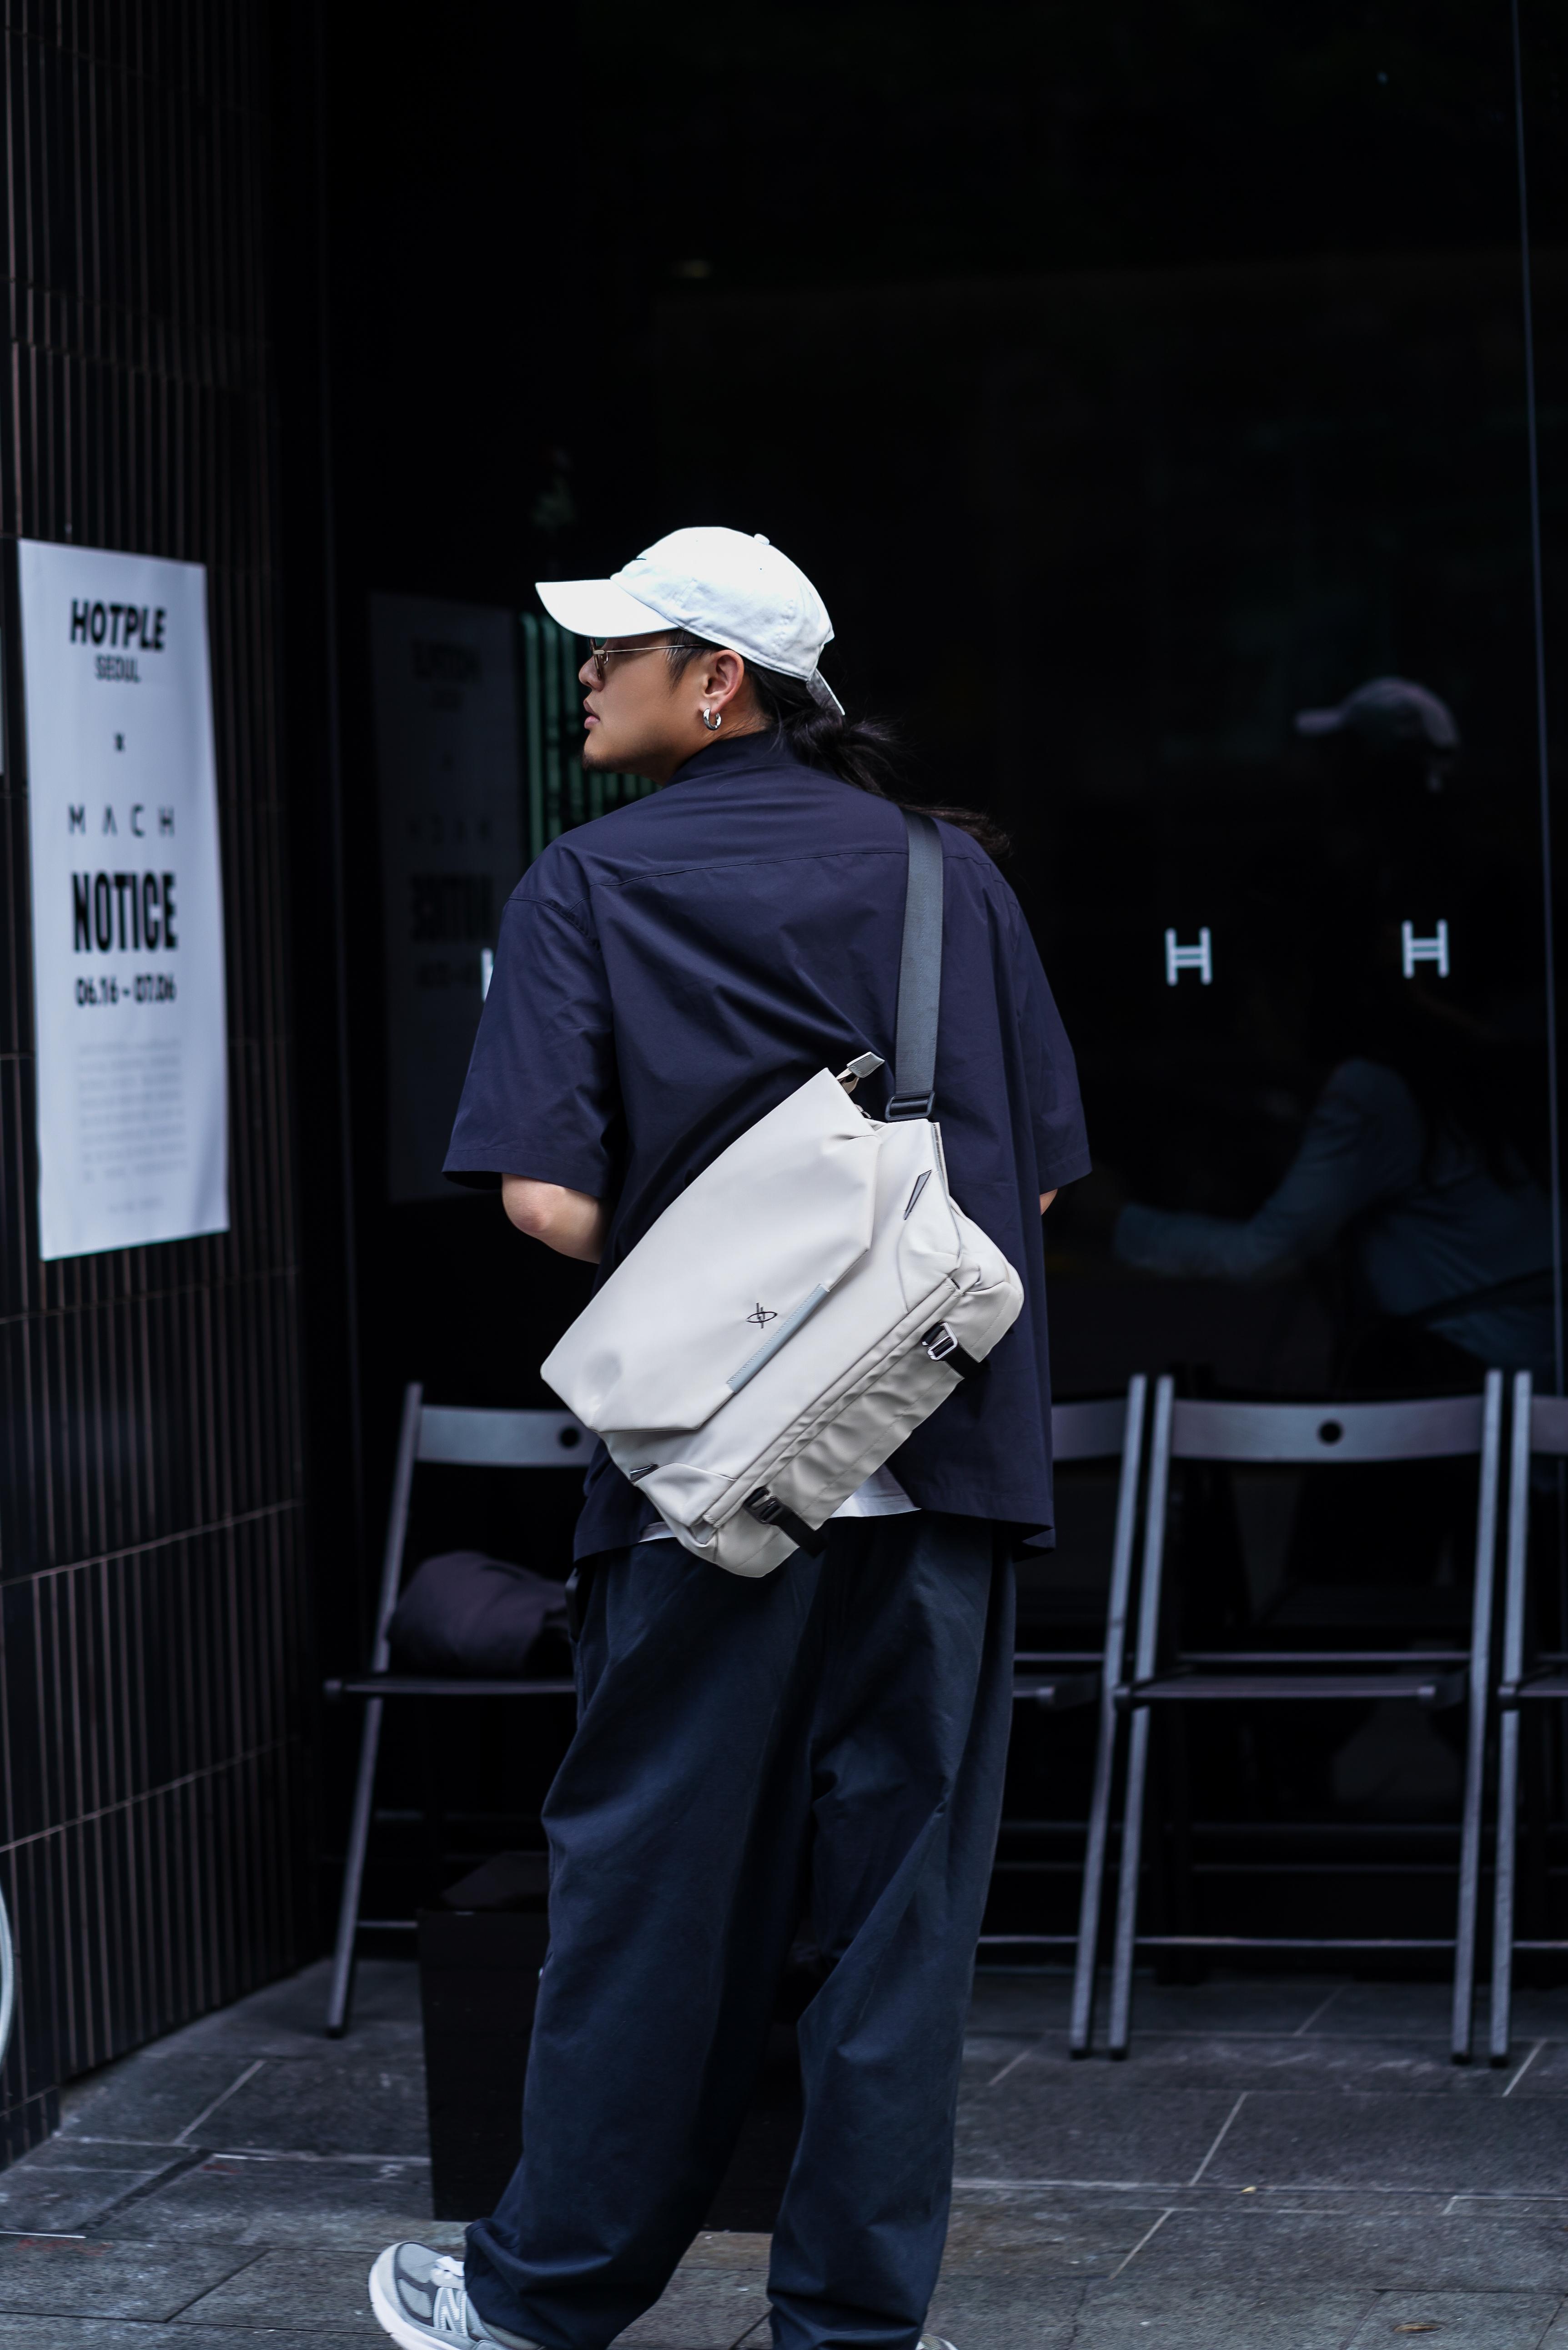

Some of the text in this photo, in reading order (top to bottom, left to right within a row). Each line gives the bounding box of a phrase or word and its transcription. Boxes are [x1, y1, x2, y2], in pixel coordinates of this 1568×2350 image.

[70, 598, 167, 651] HOTPLE
[95, 654, 141, 683] SEOUL
[68, 802, 176, 838] MACH
[71, 870, 178, 953] NOTICE
